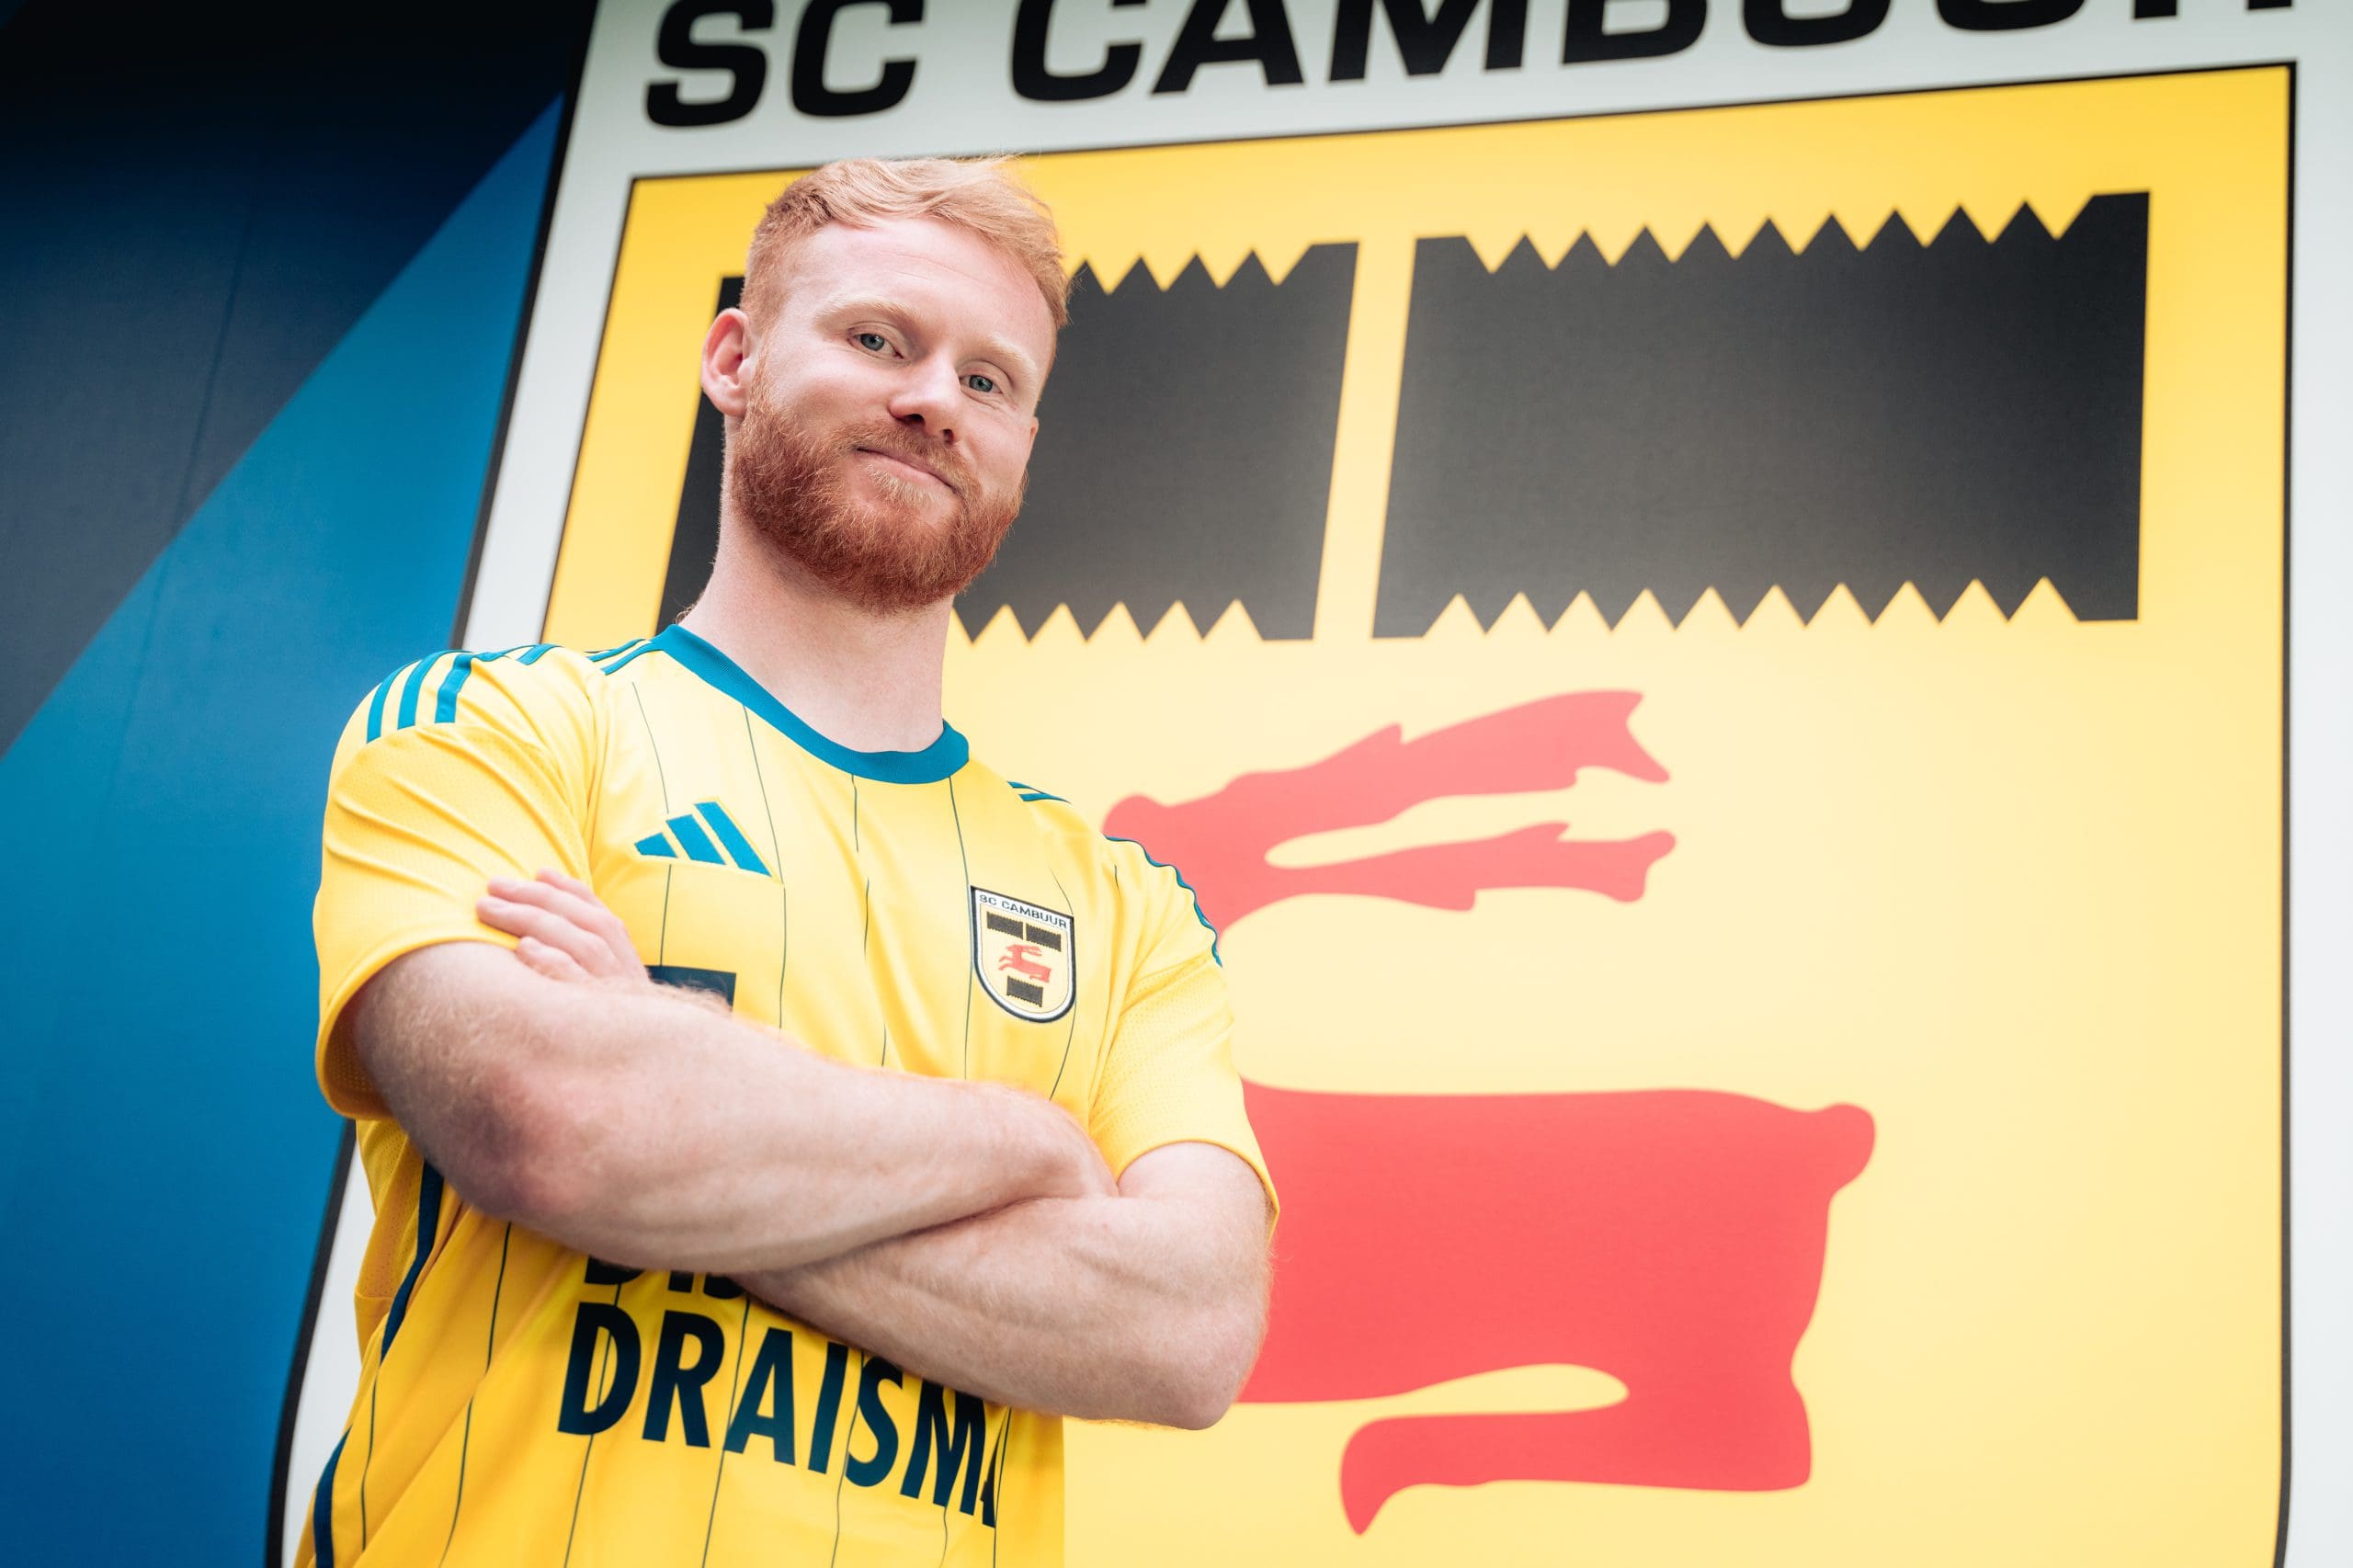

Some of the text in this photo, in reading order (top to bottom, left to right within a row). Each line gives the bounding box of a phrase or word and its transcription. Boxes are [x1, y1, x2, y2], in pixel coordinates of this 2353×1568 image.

[645, 0, 923, 127] SC
[979, 894, 1066, 928] SC CAMBUUR
